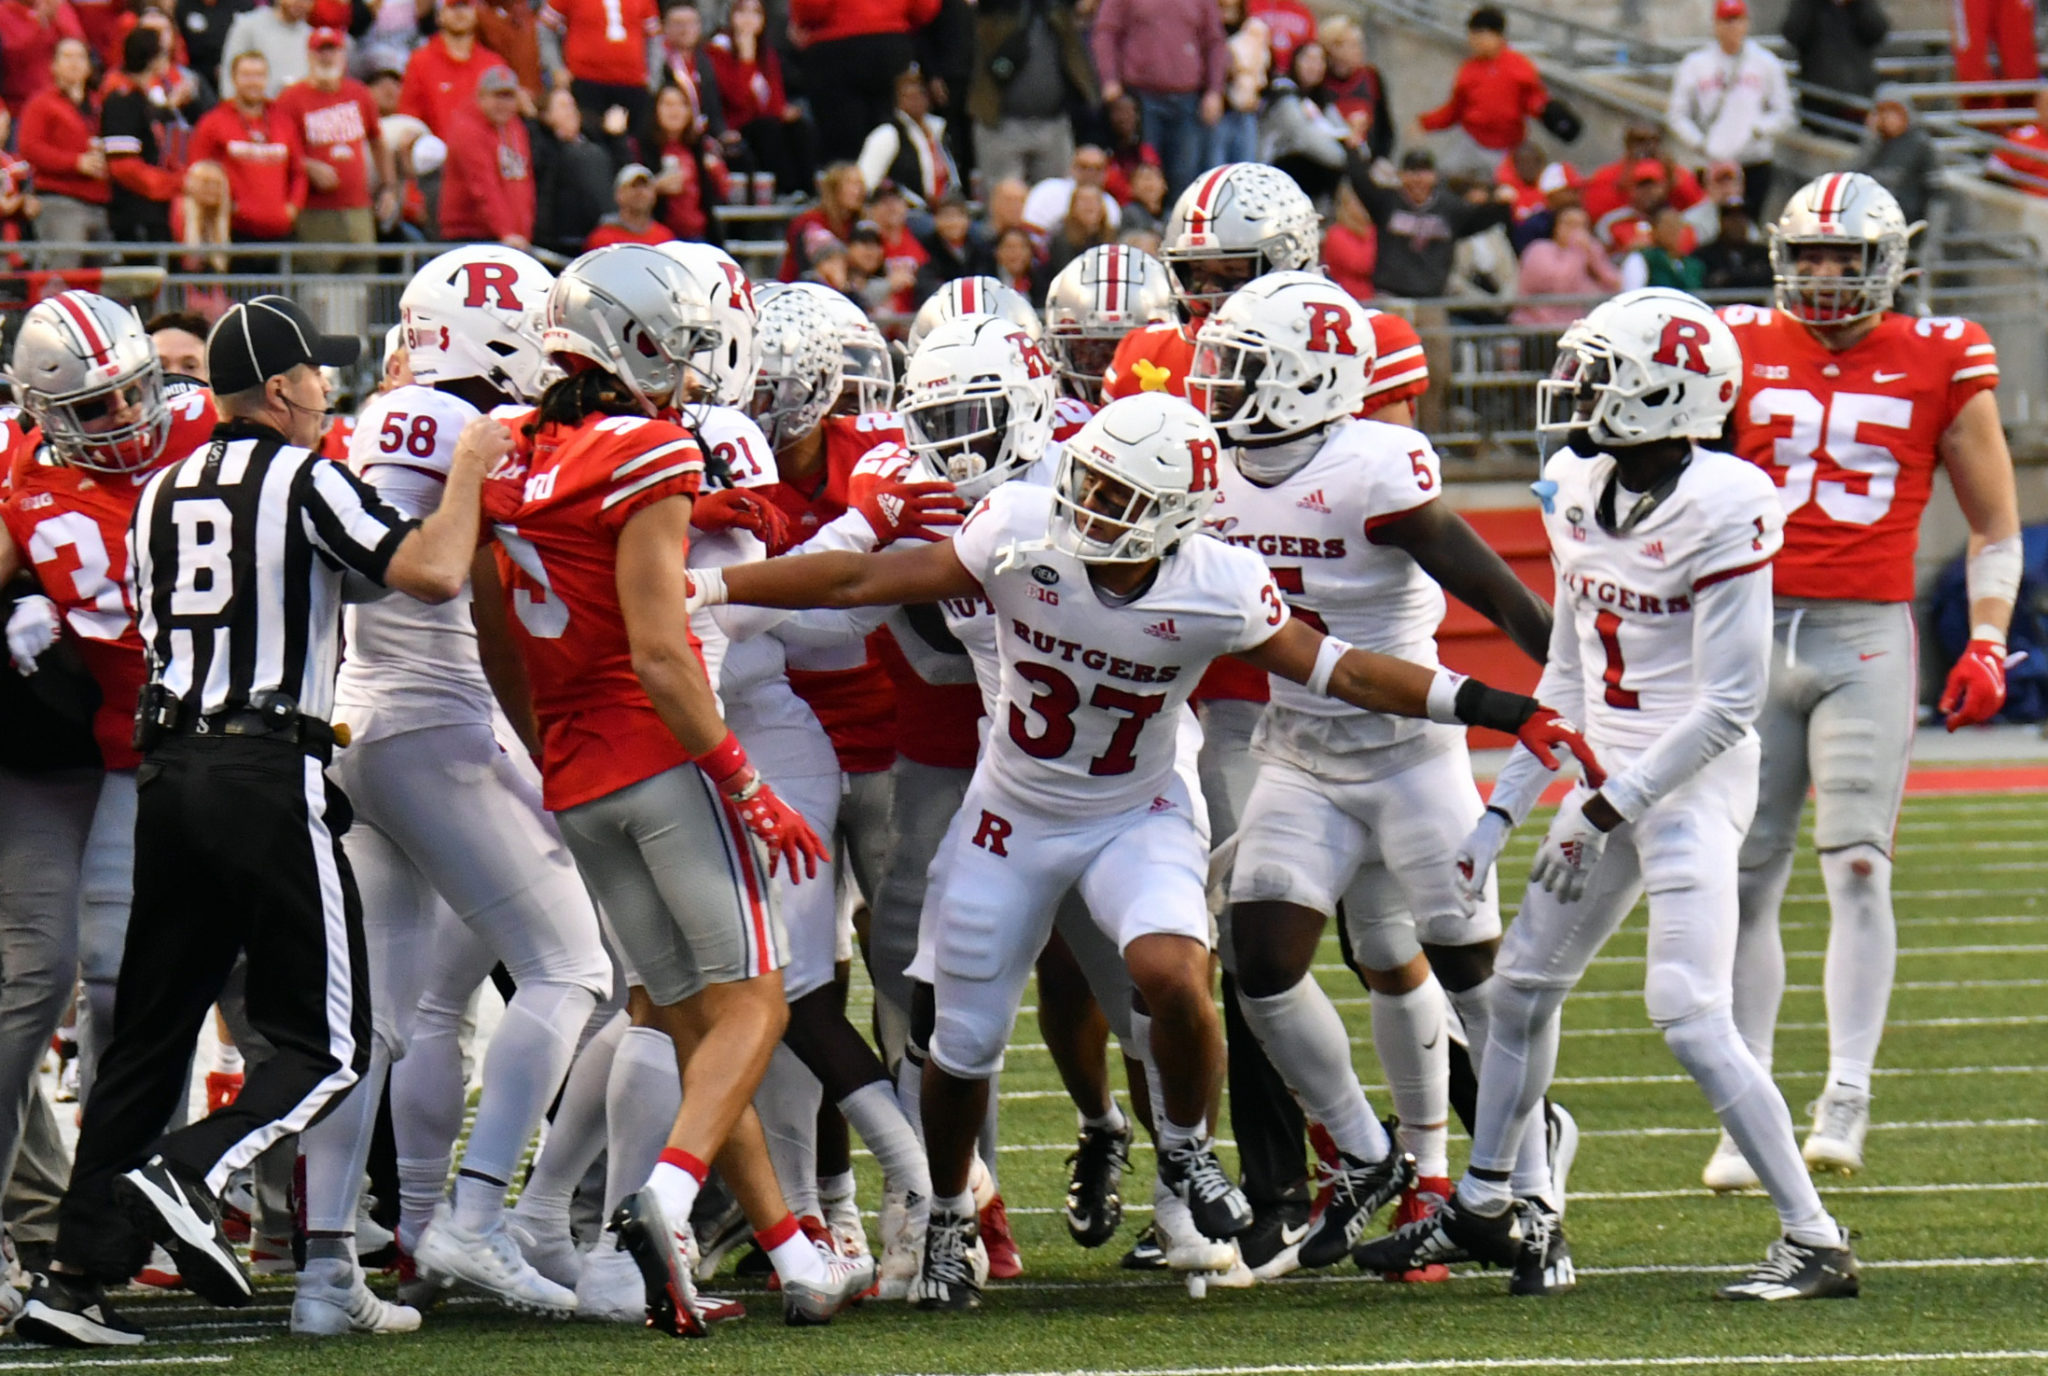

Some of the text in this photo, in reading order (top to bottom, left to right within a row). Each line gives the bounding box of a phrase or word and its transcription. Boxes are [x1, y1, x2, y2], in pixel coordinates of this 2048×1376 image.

[463, 262, 523, 311] R
[1304, 301, 1357, 355] R
[1653, 316, 1711, 374] R
[1004, 332, 1052, 379] R
[379, 412, 437, 458] 58
[712, 436, 762, 482] 21
[1750, 387, 1913, 525] 35
[1185, 438, 1218, 493] R
[1408, 449, 1433, 491] 5
[28, 510, 138, 640] 3
[171, 498, 233, 615] B
[1261, 584, 1281, 626] 3
[1012, 618, 1182, 684] RUTGERS
[1594, 608, 1641, 710] 1
[1008, 660, 1167, 776] 37
[972, 809, 1012, 858] R
